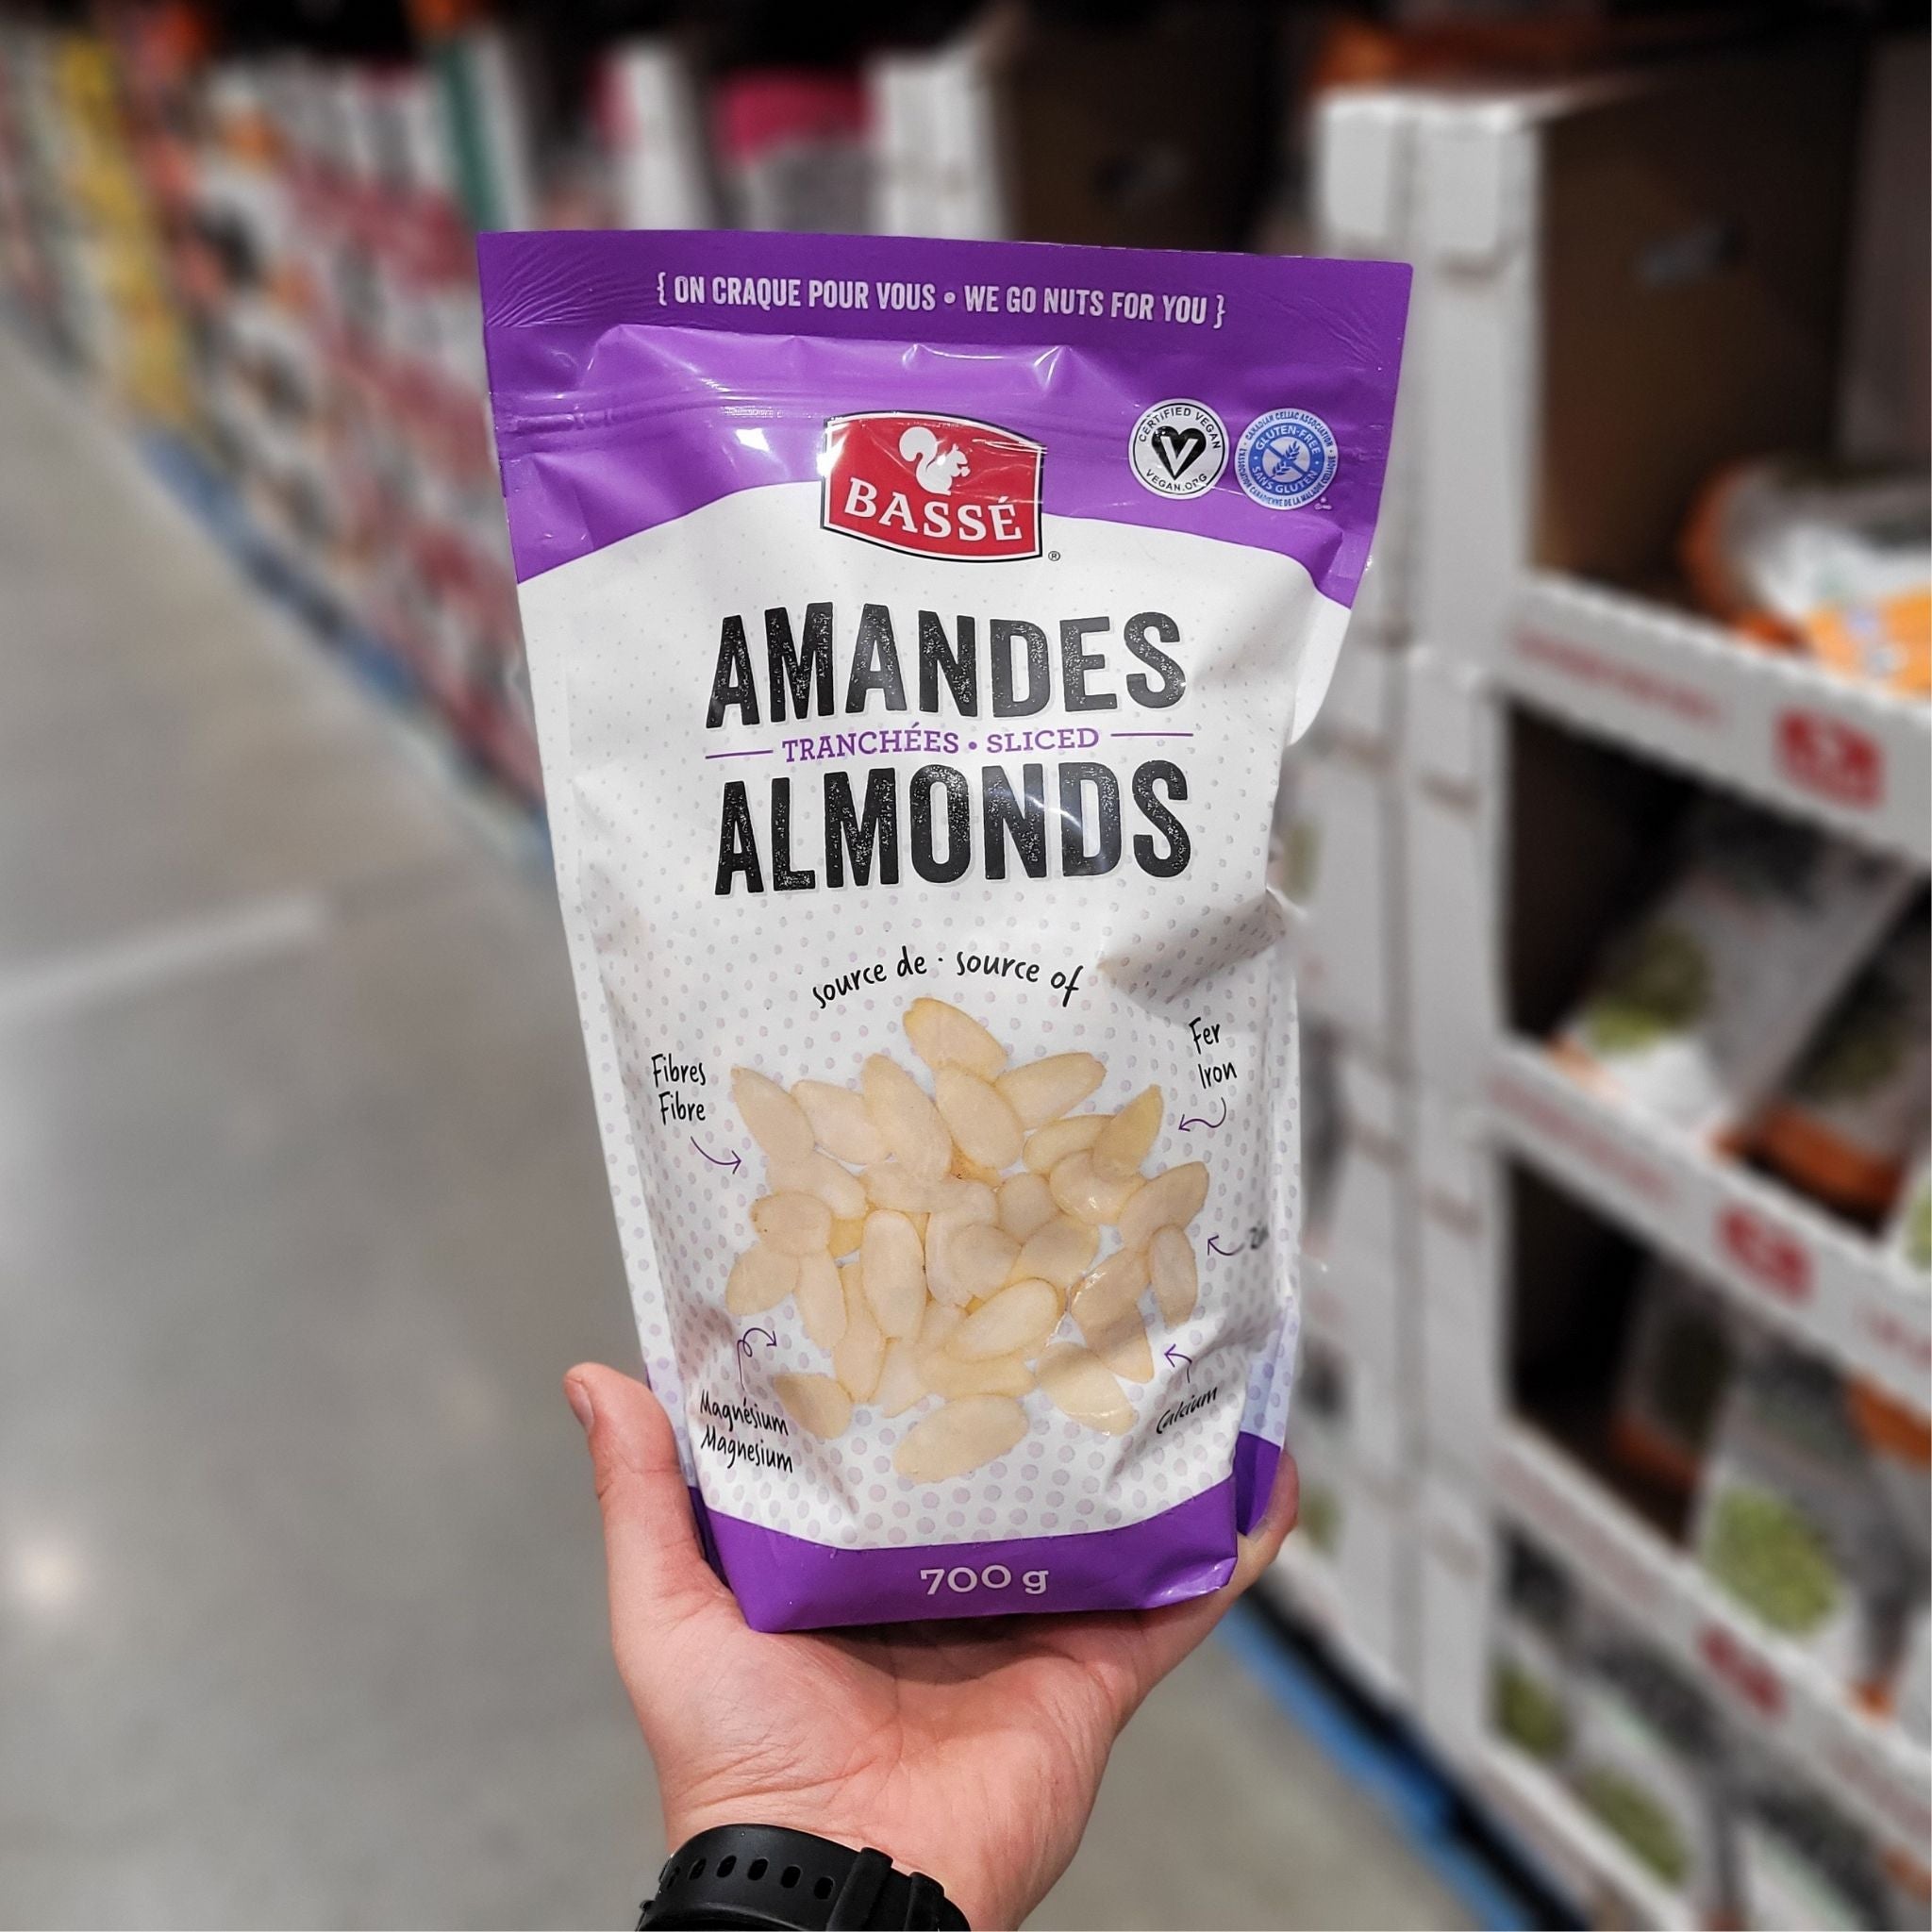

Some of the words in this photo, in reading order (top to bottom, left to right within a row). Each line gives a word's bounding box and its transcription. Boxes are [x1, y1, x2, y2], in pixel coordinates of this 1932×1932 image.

[674, 275, 706, 304] ON
[712, 276, 802, 311] CRAQUE
[808, 280, 869, 309] POUR
[876, 282, 937, 310] VOUS
[964, 285, 1000, 312] WE
[1006, 286, 1037, 313] GO
[1043, 288, 1104, 316] NUTS
[1110, 291, 1155, 320] FOR
[1162, 294, 1208, 325] YOU
[1139, 407, 1191, 442] CERTIFIED
[1195, 413, 1222, 450] VEGAN
[1256, 425, 1321, 455] GLUTEN-FREE
[1275, 411, 1300, 421] CELIAC
[1300, 413, 1334, 447] ASSOCIATION
[1146, 469, 1208, 491] VEGAN.ORG
[1252, 466, 1274, 490] SANS
[1274, 471, 1319, 493] GLUTEN
[844, 476, 1023, 541] BASSÉ
[706, 601, 1188, 729] AMANDES
[782, 722, 960, 762] TRANCHÉES
[986, 727, 1100, 754] SLICED
[714, 759, 1191, 895] ALMONDS
[812, 963, 888, 1009] source
[896, 945, 927, 977] de
[956, 951, 1040, 983] source
[1050, 965, 1084, 1008] of
[1189, 1017, 1221, 1055] Fer
[651, 1053, 707, 1088] Fibres
[1197, 1061, 1238, 1090] Iron
[658, 1091, 706, 1126] Fibre
[700, 1389, 789, 1436] Magnésium
[1156, 1386, 1218, 1435] Calcium
[700, 1424, 793, 1474] Magnesium
[920, 1564, 1012, 1595] 700
[1022, 1570, 1049, 1595] g
